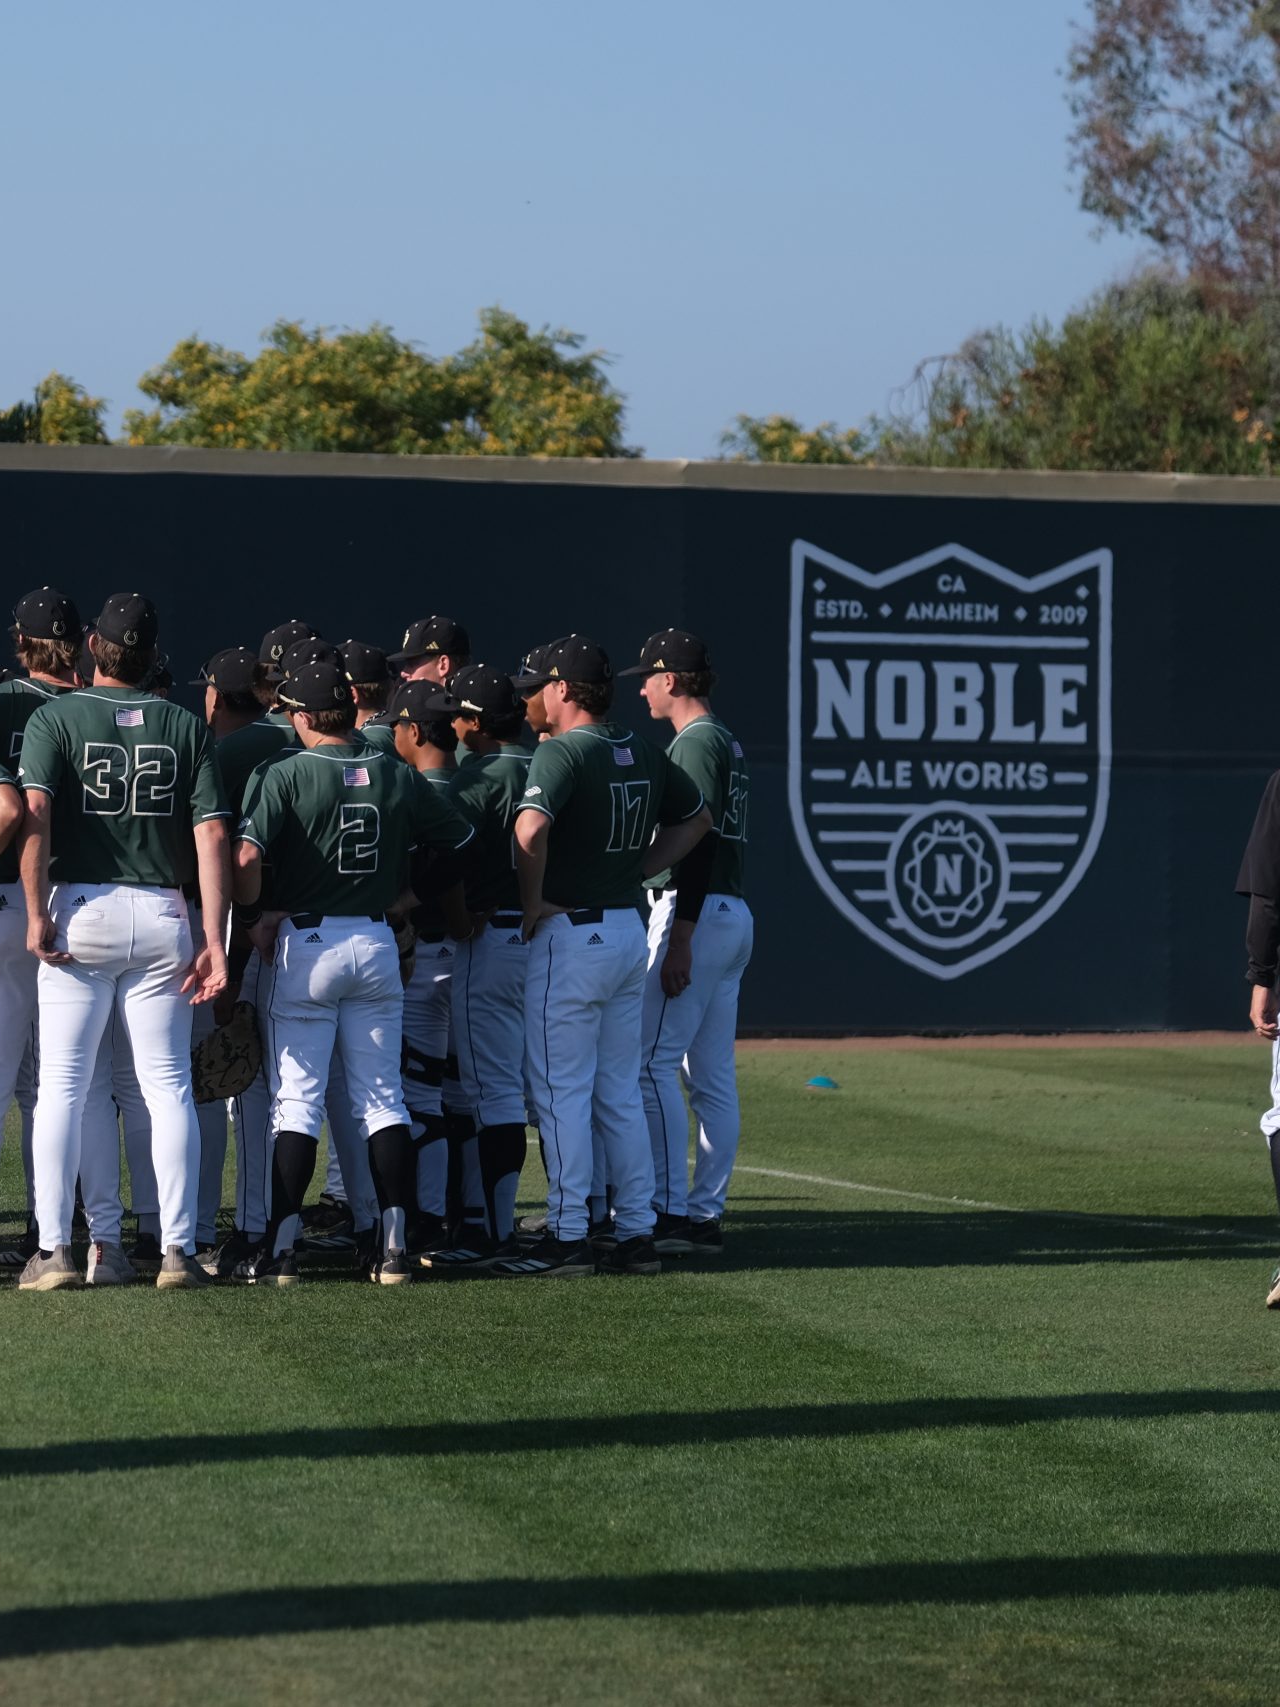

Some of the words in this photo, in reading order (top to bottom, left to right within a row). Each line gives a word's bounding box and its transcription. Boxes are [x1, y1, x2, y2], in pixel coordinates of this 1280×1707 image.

[937, 573, 966, 593] CA
[814, 600, 868, 620] ESTD.
[905, 602, 999, 623] ANAHEIM
[1039, 605, 1088, 625] 2009
[812, 658, 1087, 744] NOBLE
[82, 743, 178, 817] 32
[850, 760, 912, 788] ALE
[923, 761, 1049, 791] WORKS
[338, 804, 381, 874] 2
[605, 780, 652, 853] 17
[934, 854, 964, 896] N
